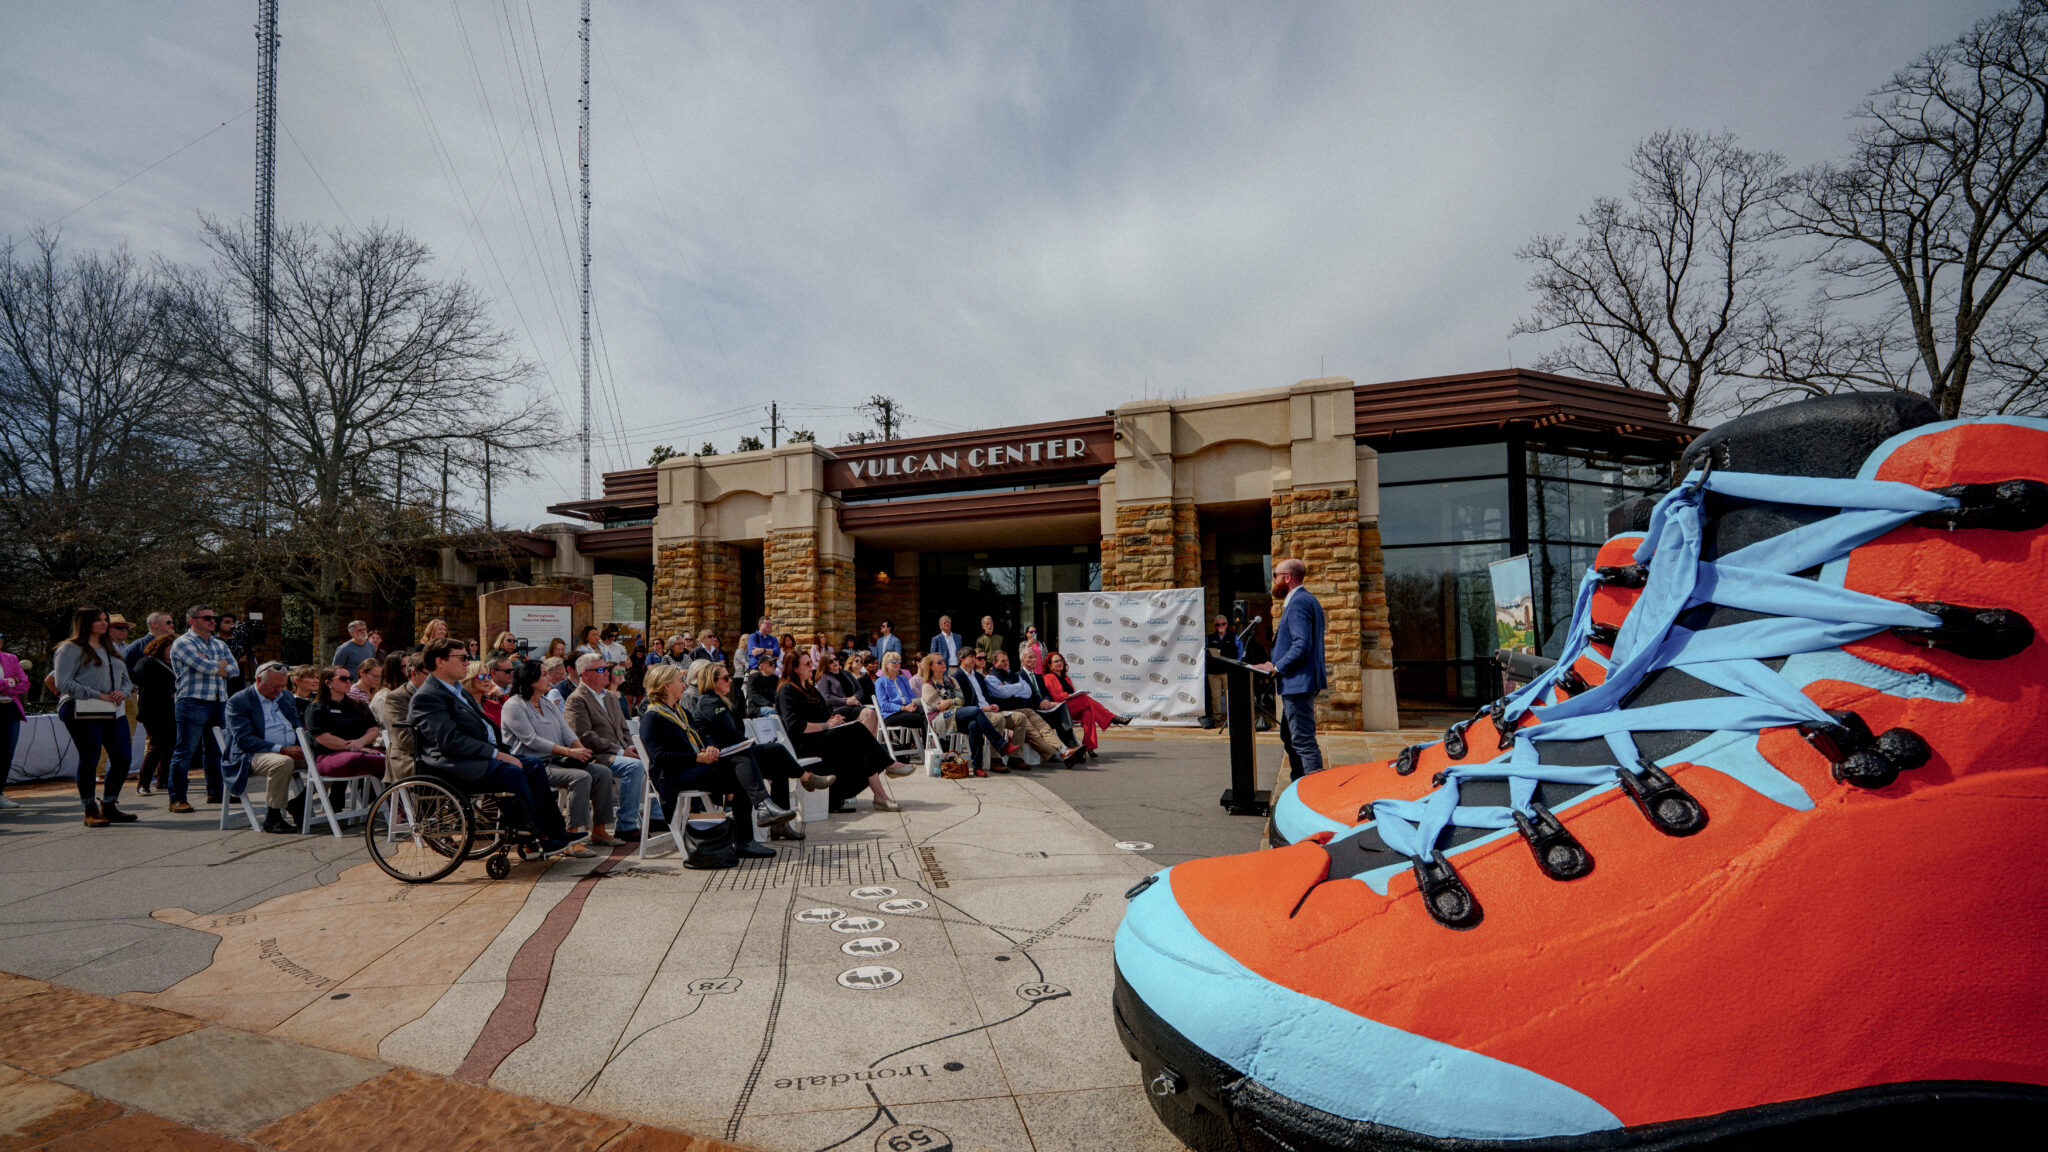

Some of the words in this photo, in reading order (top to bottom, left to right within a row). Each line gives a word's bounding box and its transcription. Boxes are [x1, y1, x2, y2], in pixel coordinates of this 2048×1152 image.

[848, 451, 958, 479] VULCAN
[967, 438, 1086, 468] CENTER
[918, 846, 950, 888] Birmingham
[271, 956, 339, 988] Mountain
[699, 981, 729, 991] 78
[1024, 985, 1056, 997] 20
[774, 1064, 933, 1091] Irondale
[888, 1129, 933, 1152] 59
